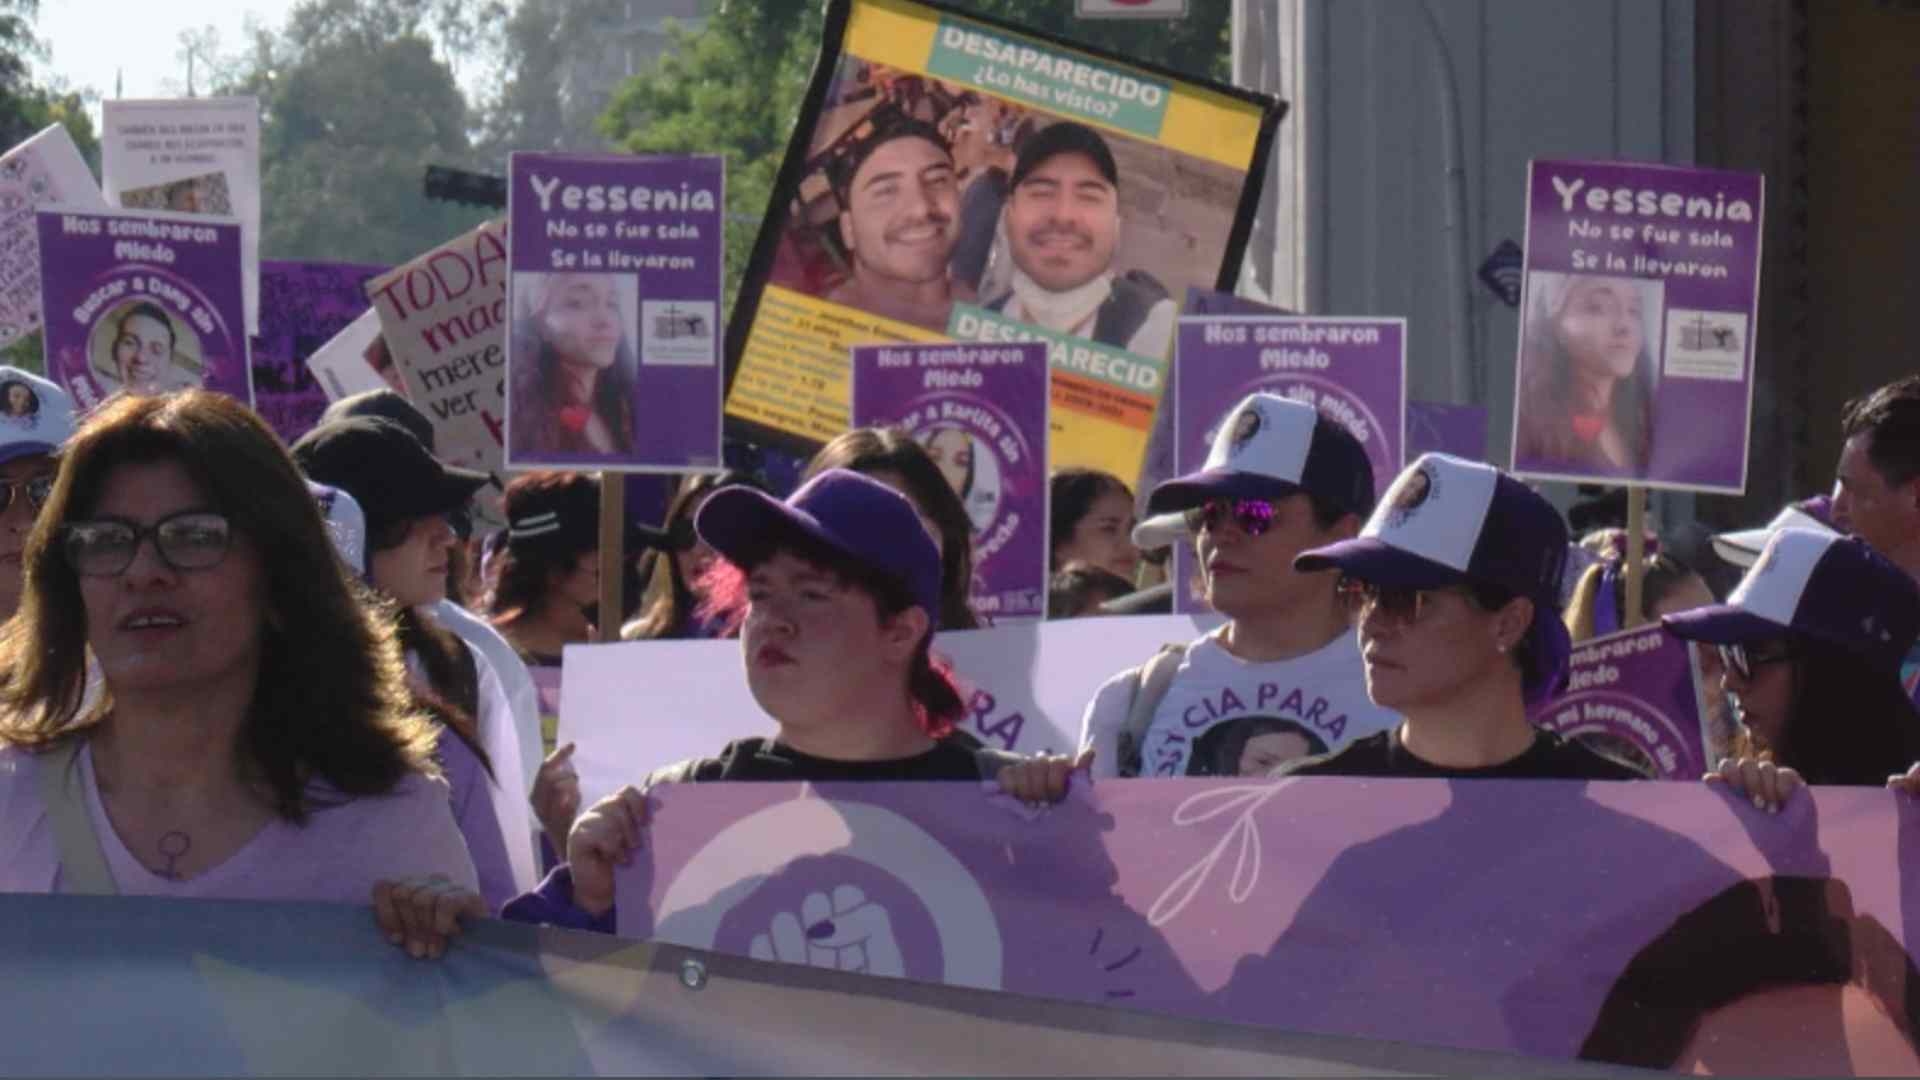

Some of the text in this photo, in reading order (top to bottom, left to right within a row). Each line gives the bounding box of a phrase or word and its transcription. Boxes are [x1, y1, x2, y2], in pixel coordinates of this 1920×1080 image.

[942, 26, 1162, 107] DESAPARECIDO
[1013, 75, 1049, 98] has
[1055, 87, 1120, 120] visto?
[530, 174, 715, 212] Yessenia
[1551, 175, 1752, 222] Yessenia
[62, 217, 218, 242] Nos sembraron
[547, 220, 699, 239] No se fue sola
[1569, 220, 1734, 248] No se fue sola
[115, 242, 175, 263] Miedo
[552, 250, 695, 270] Se la llevaron
[1572, 250, 1728, 279] Se la llevaron
[372, 224, 506, 319] TODA
[1204, 324, 1379, 344] Nos sembraron
[418, 344, 505, 391] mere
[877, 346, 1024, 367] Nos sembraron
[1259, 349, 1330, 369] Miedo
[924, 369, 983, 388] Miedo
[429, 390, 476, 420] ver
[1570, 634, 1662, 667] mbraron
[1568, 665, 1619, 691] iedo
[1257, 682, 1348, 741] PARA
